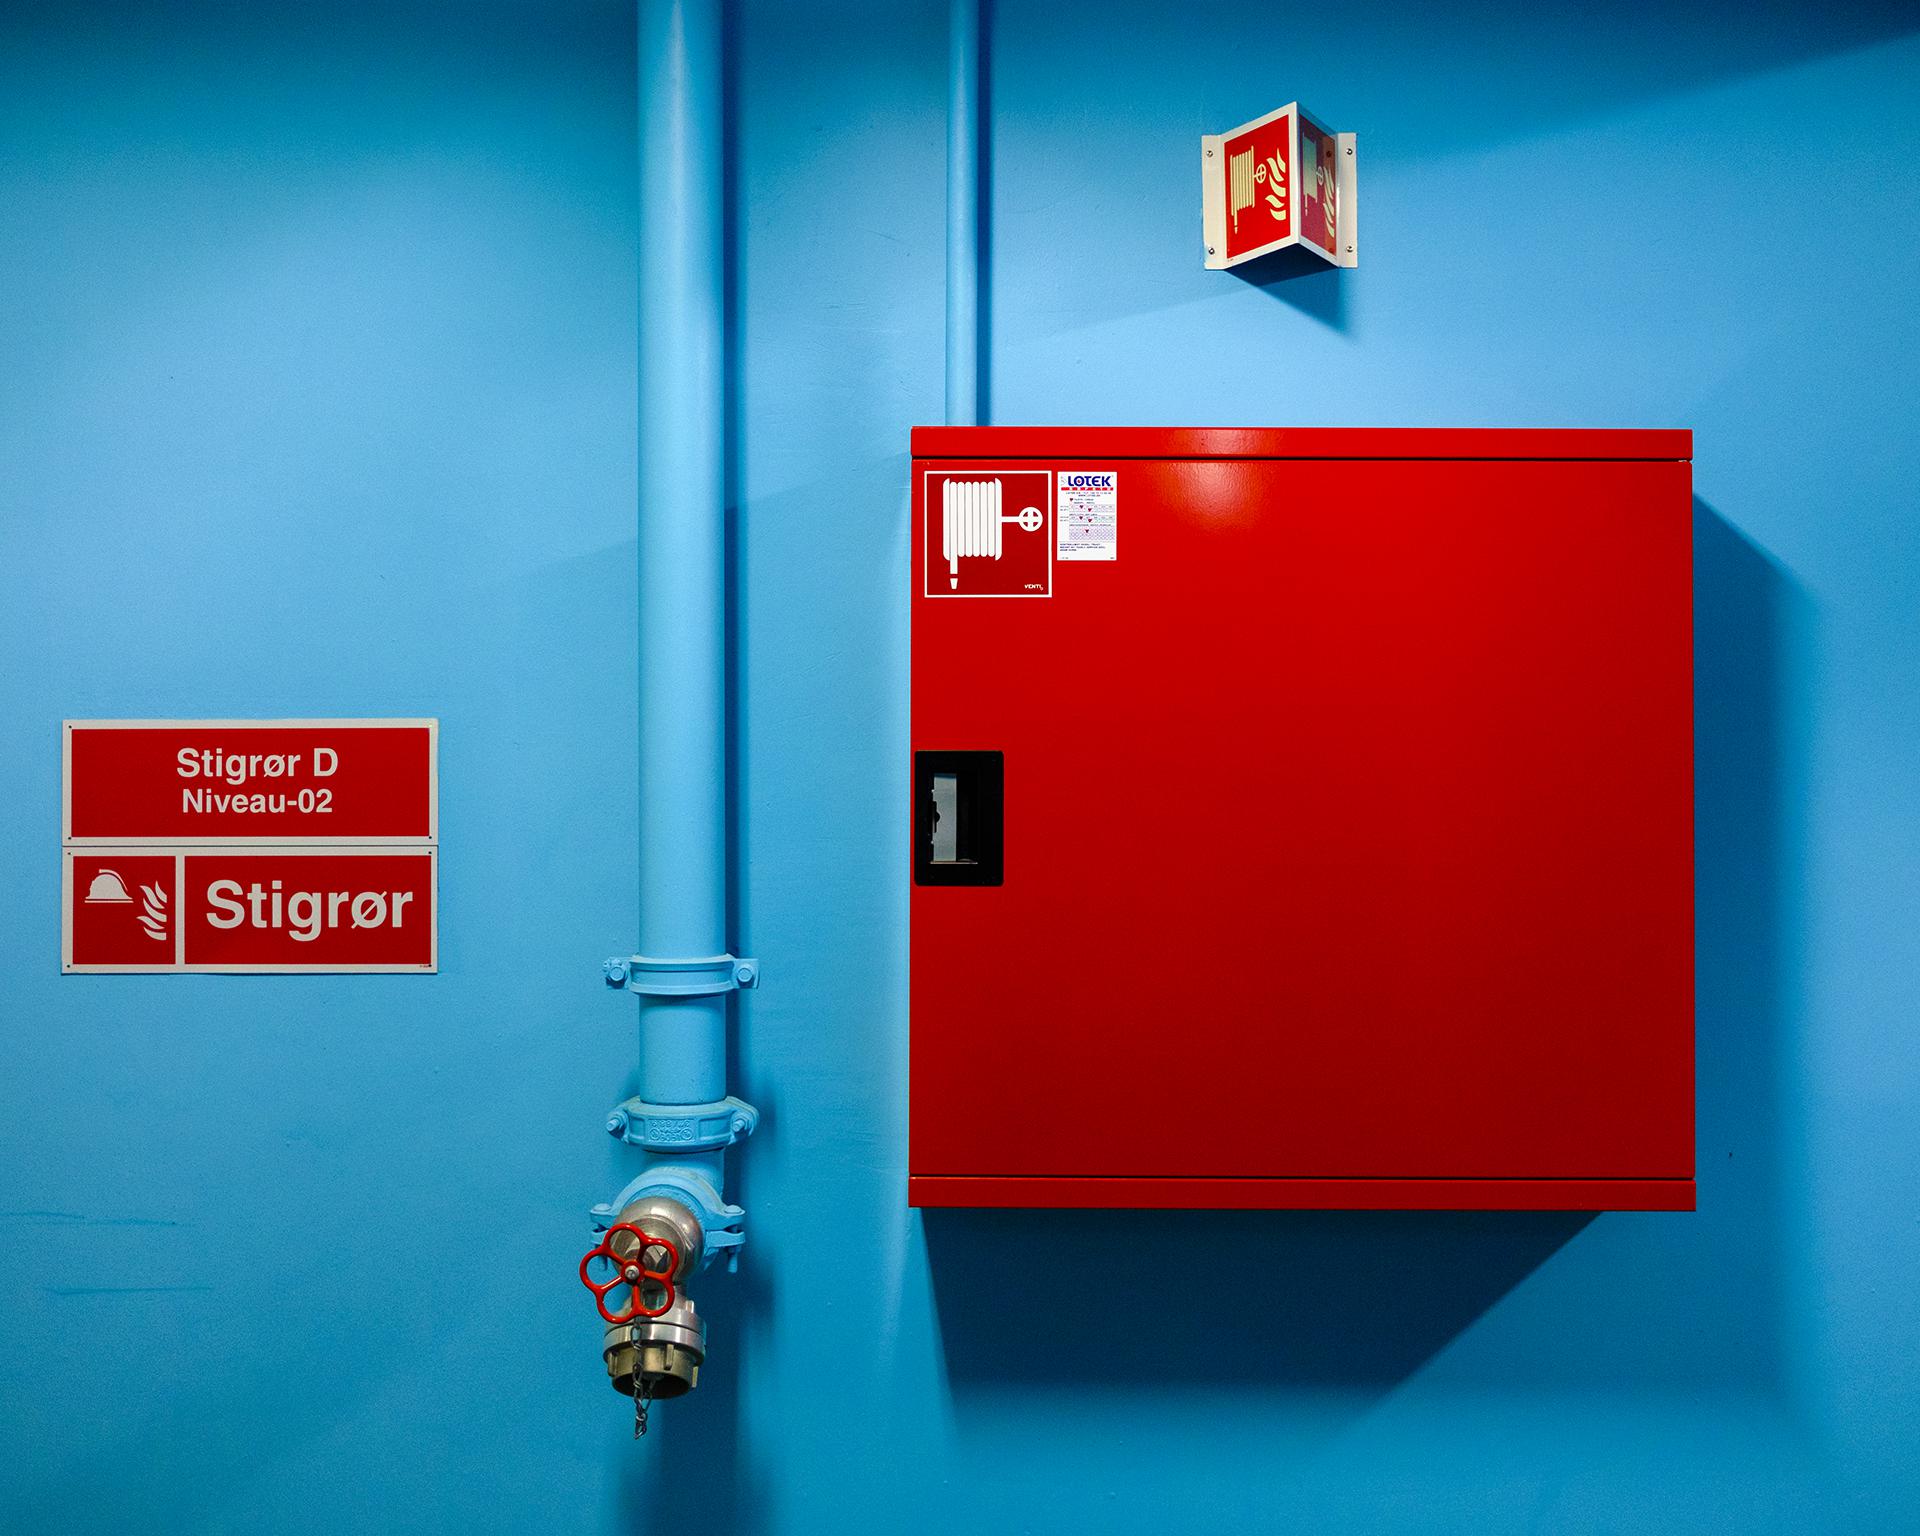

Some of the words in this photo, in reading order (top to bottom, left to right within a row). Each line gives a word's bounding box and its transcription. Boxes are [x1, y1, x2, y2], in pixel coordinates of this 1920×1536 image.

[1067, 475, 1111, 486] LOTEK
[177, 748, 300, 785] Stigrør
[314, 748, 338, 776] D
[183, 789, 332, 813] Niveau-02
[207, 880, 413, 941] Stigrør
